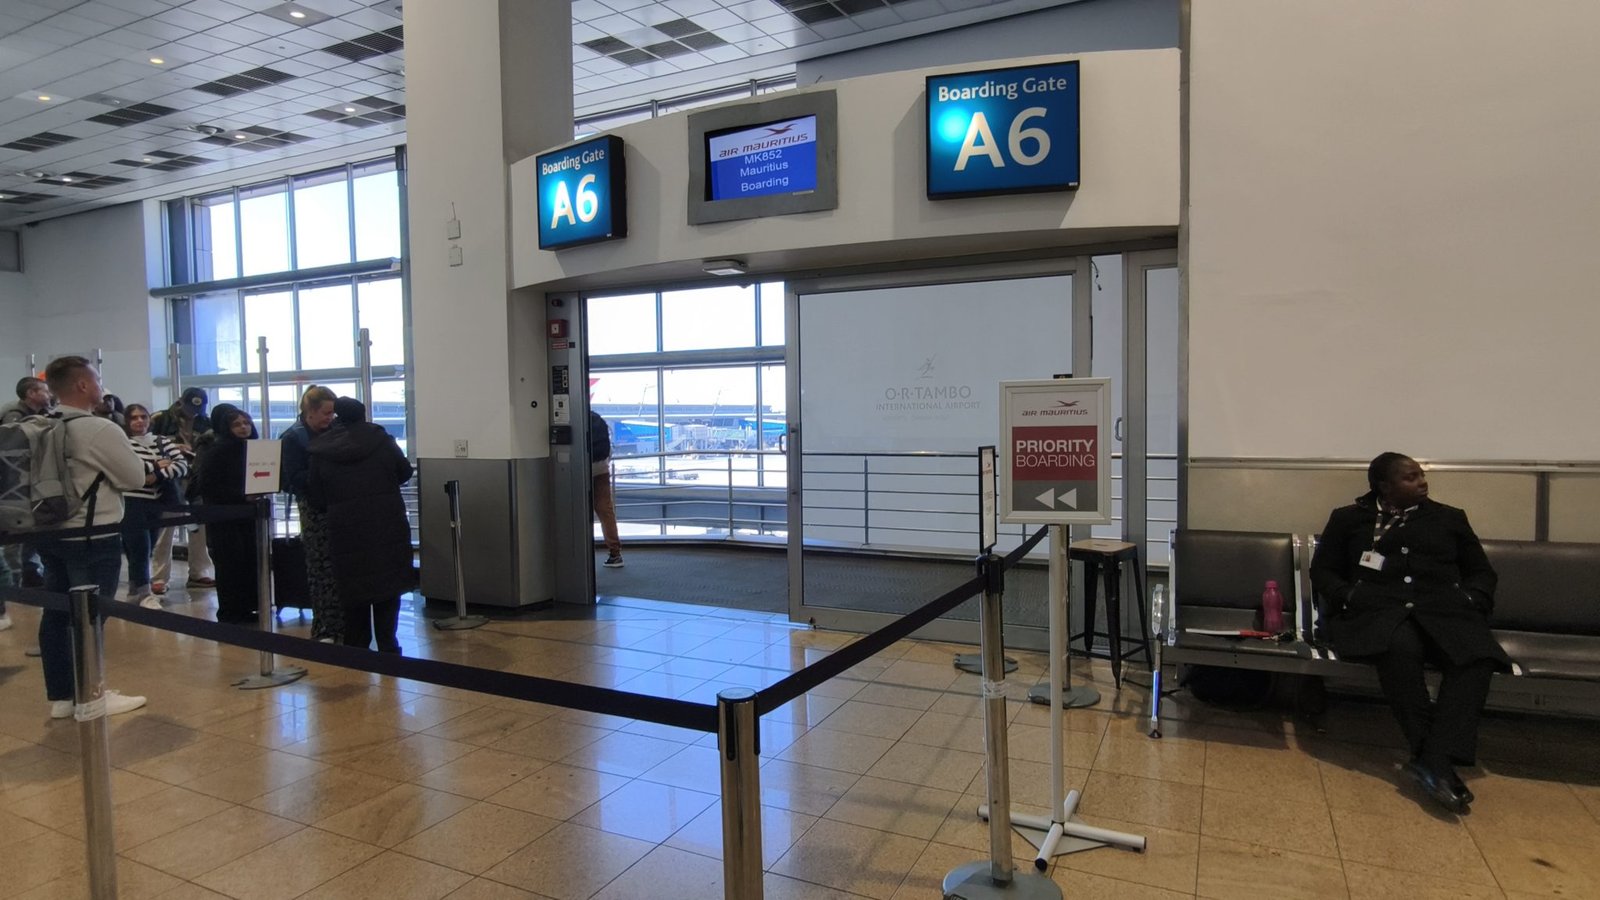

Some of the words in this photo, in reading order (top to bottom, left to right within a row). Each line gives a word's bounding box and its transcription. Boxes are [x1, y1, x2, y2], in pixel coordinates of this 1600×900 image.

[938, 81, 1018, 102] Boarding
[1022, 76, 1067, 93] Gate
[953, 106, 1051, 172] A6
[542, 156, 581, 175] Boarding
[581, 149, 605, 164] Gate
[744, 149, 782, 165] MK852
[740, 161, 789, 177] Mauritius
[741, 176, 789, 192] Boarding
[550, 173, 599, 229] A6
[876, 401, 942, 411] INTERNATIONAL
[945, 400, 981, 409] AIRPORT
[1016, 439, 1094, 453] PRIORITY
[1016, 454, 1096, 467] BOARDING
